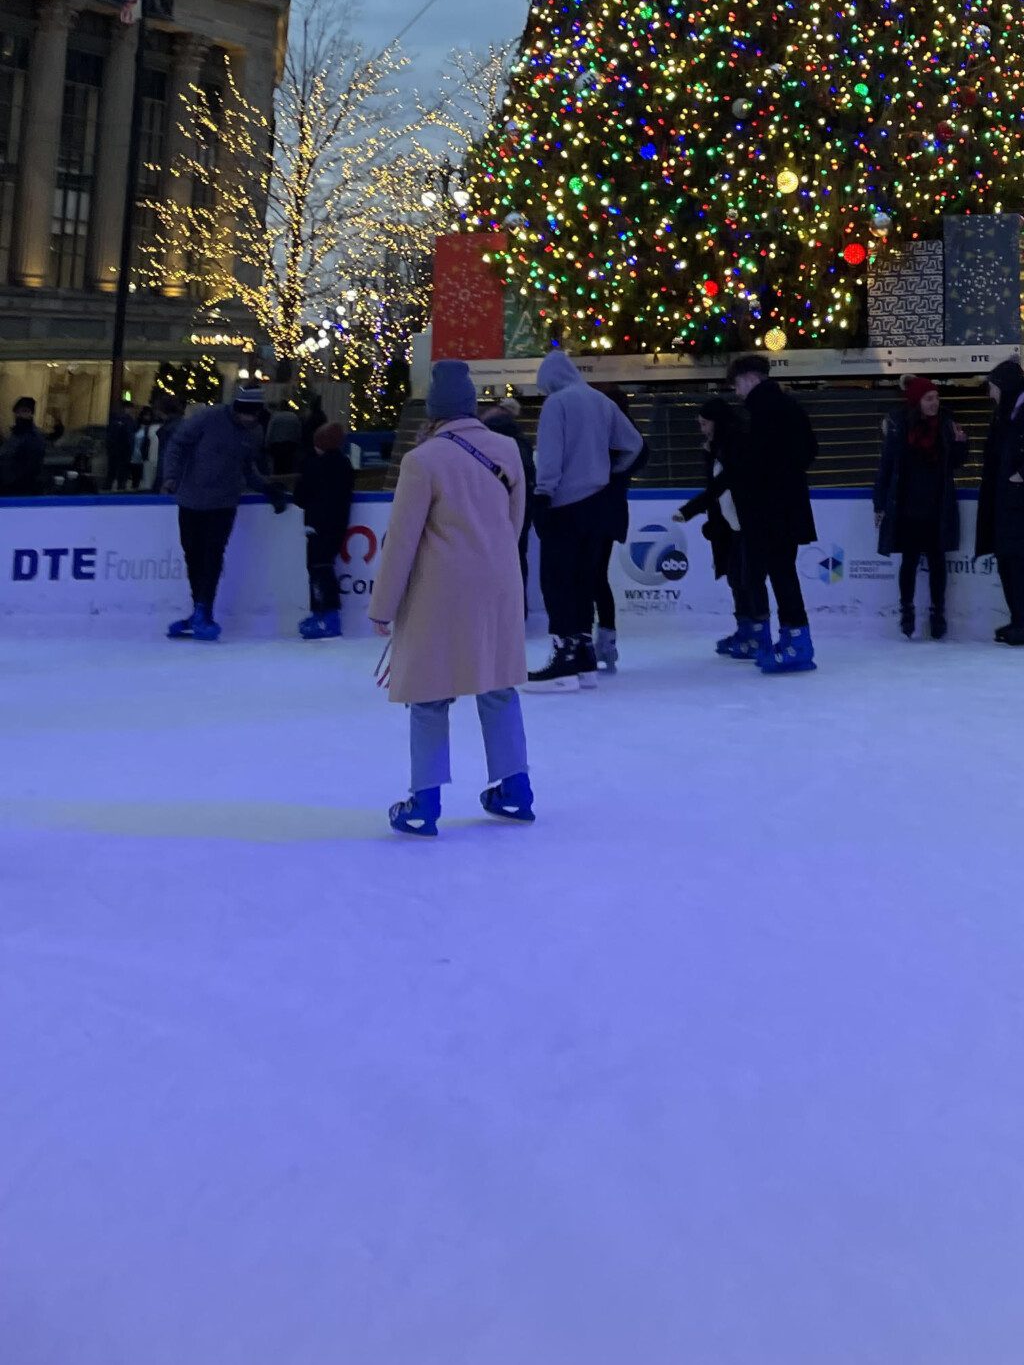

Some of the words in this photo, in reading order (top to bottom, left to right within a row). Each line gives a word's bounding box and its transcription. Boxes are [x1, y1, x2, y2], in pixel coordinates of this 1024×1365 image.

[971, 354, 989, 363] DTE
[13, 547, 97, 581] DTE
[661, 558, 687, 571] abc
[624, 589, 680, 600] WXYZ-TV
